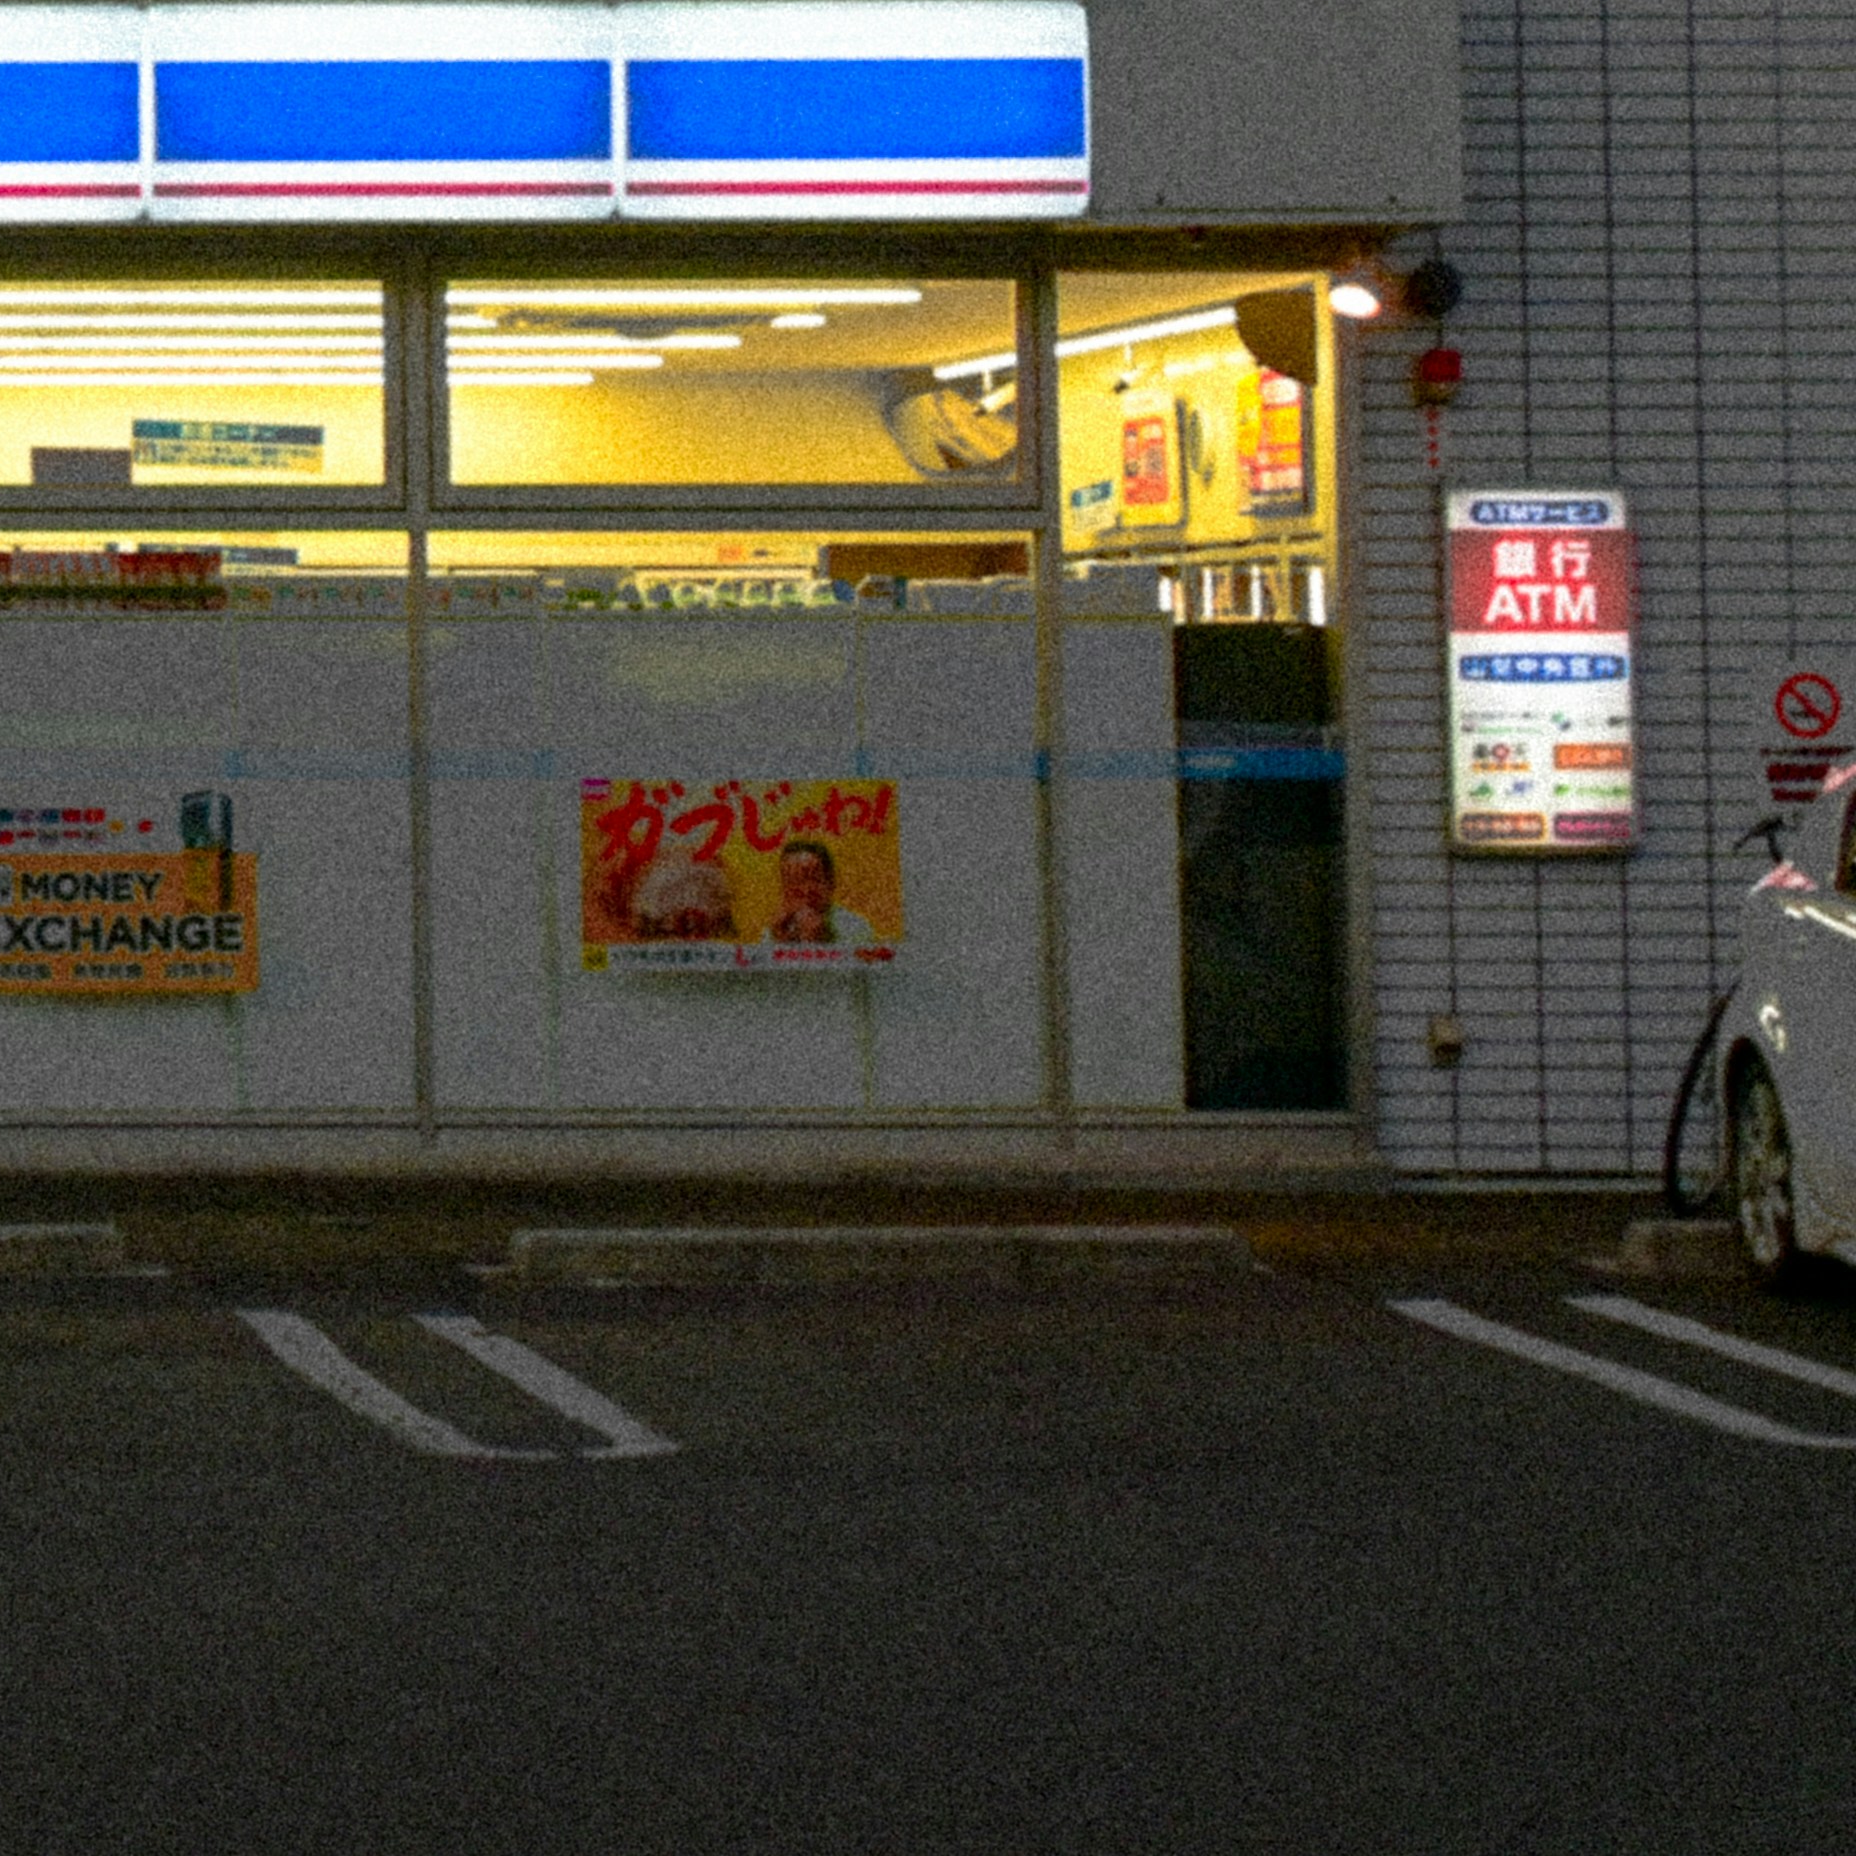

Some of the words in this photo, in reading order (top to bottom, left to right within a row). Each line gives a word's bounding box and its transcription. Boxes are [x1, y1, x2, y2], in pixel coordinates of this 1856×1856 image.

[1476, 502, 1603, 523] ATMサービス
[1494, 540, 1591, 579] 銀行
[1483, 584, 1598, 624] ATM
[20, 871, 165, 902] MONEY
